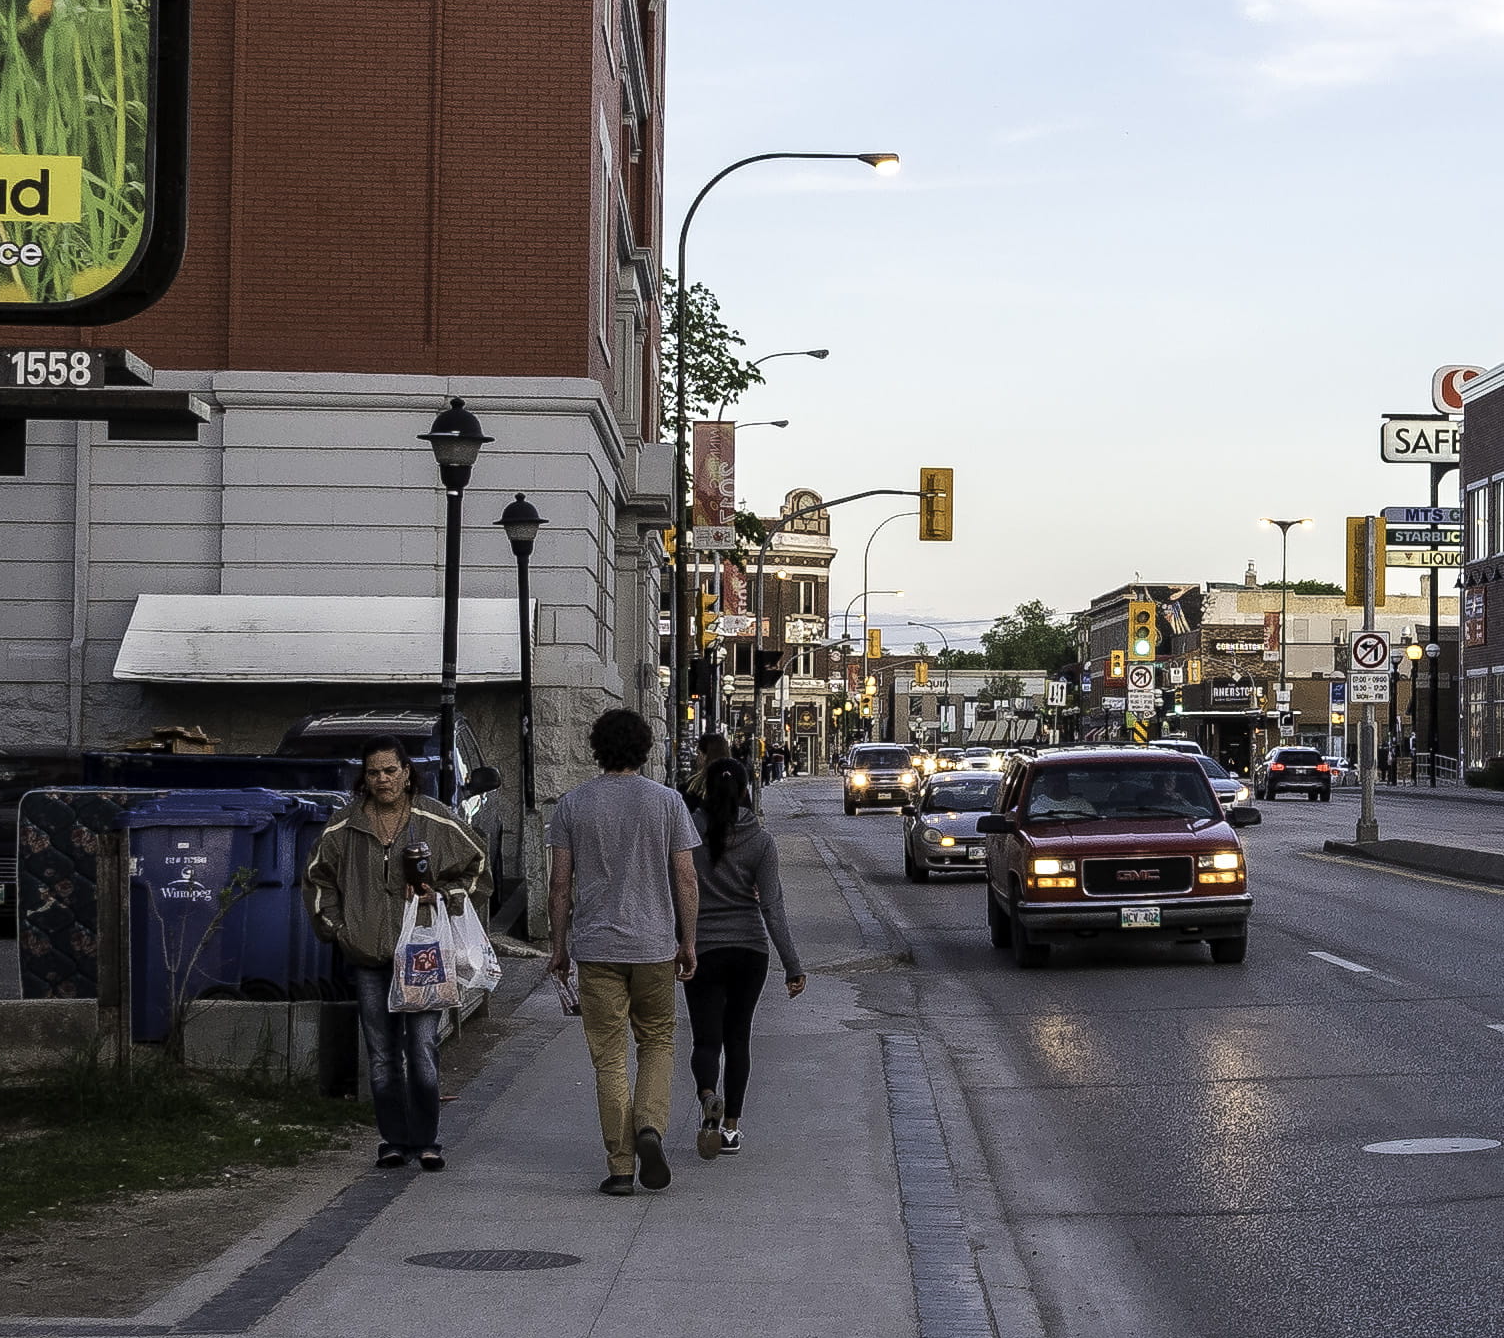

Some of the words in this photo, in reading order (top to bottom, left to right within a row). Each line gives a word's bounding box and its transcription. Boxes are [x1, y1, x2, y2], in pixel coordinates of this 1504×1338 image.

[11, 351, 91, 385] 1558
[1405, 508, 1443, 522] MTS
[1115, 869, 1161, 882] GMC
